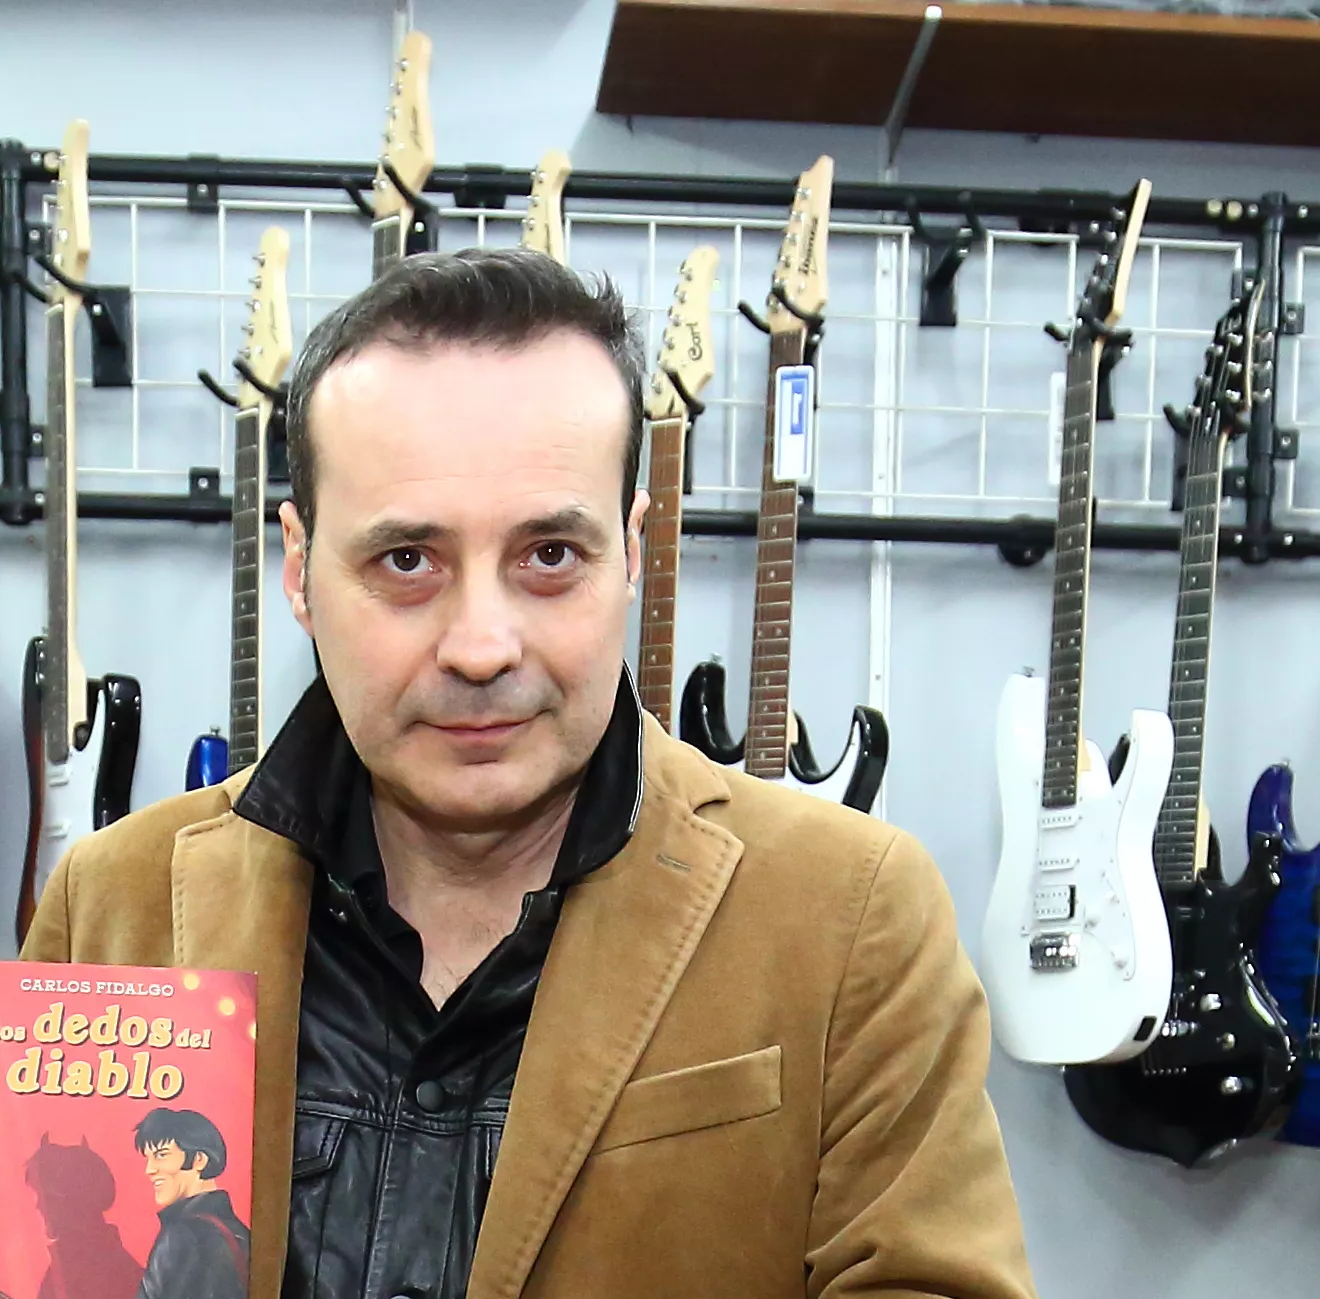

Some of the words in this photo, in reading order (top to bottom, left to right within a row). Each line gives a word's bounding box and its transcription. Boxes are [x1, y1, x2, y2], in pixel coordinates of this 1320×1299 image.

[20, 978, 91, 994] CARLOS
[95, 981, 174, 997] FIDALGO
[33, 1001, 173, 1048] dedos
[175, 1028, 212, 1049] del
[6, 1046, 183, 1099] diablo
